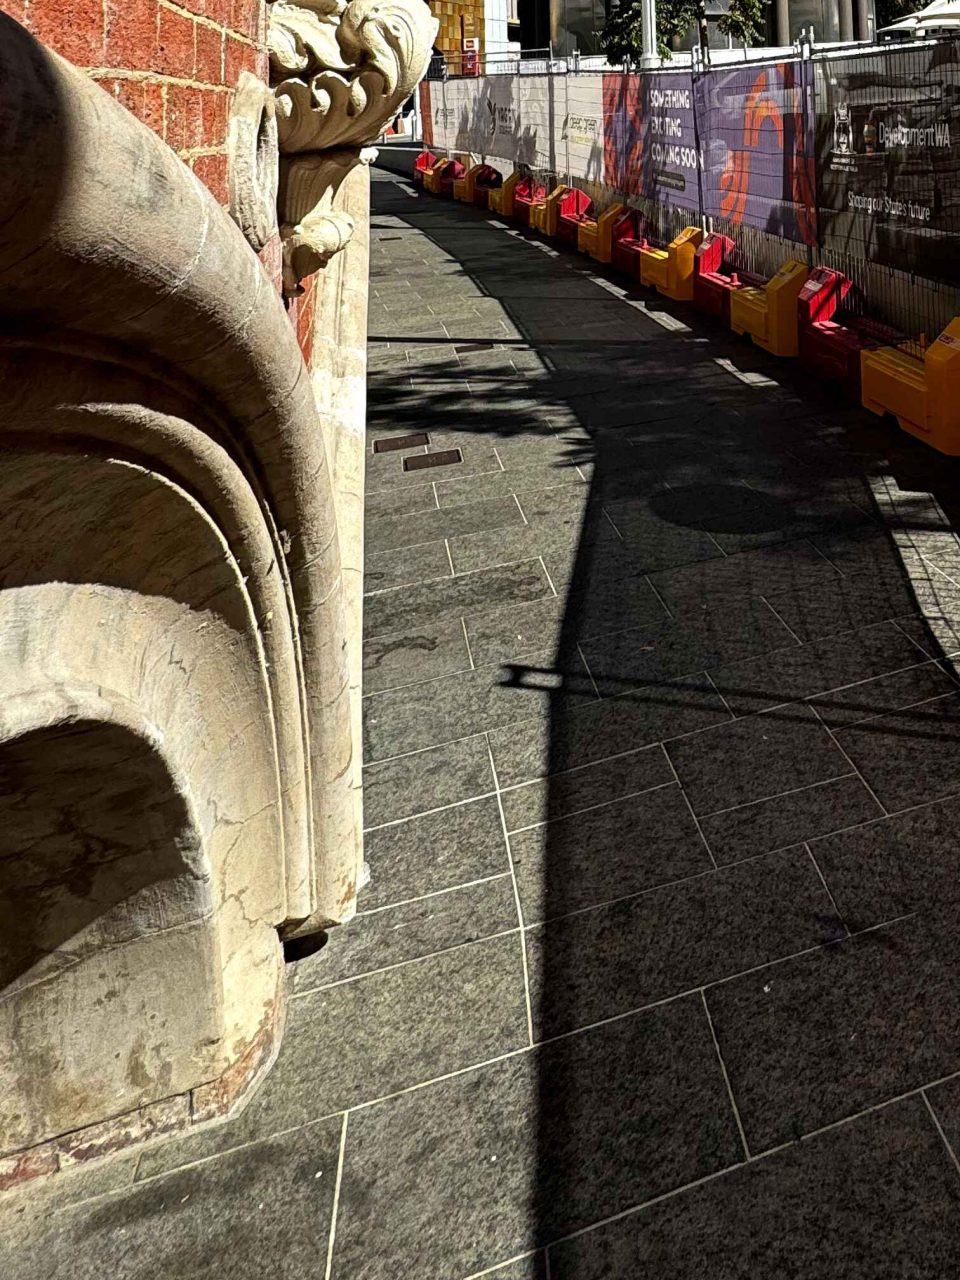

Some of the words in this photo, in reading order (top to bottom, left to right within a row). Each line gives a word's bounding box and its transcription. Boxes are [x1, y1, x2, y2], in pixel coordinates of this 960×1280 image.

[650, 89, 690, 109] SOMETHING
[651, 142, 680, 166] COMING
[847, 190, 872, 214] Shaping
[872, 200, 883, 212] our
[907, 199, 931, 221] future
